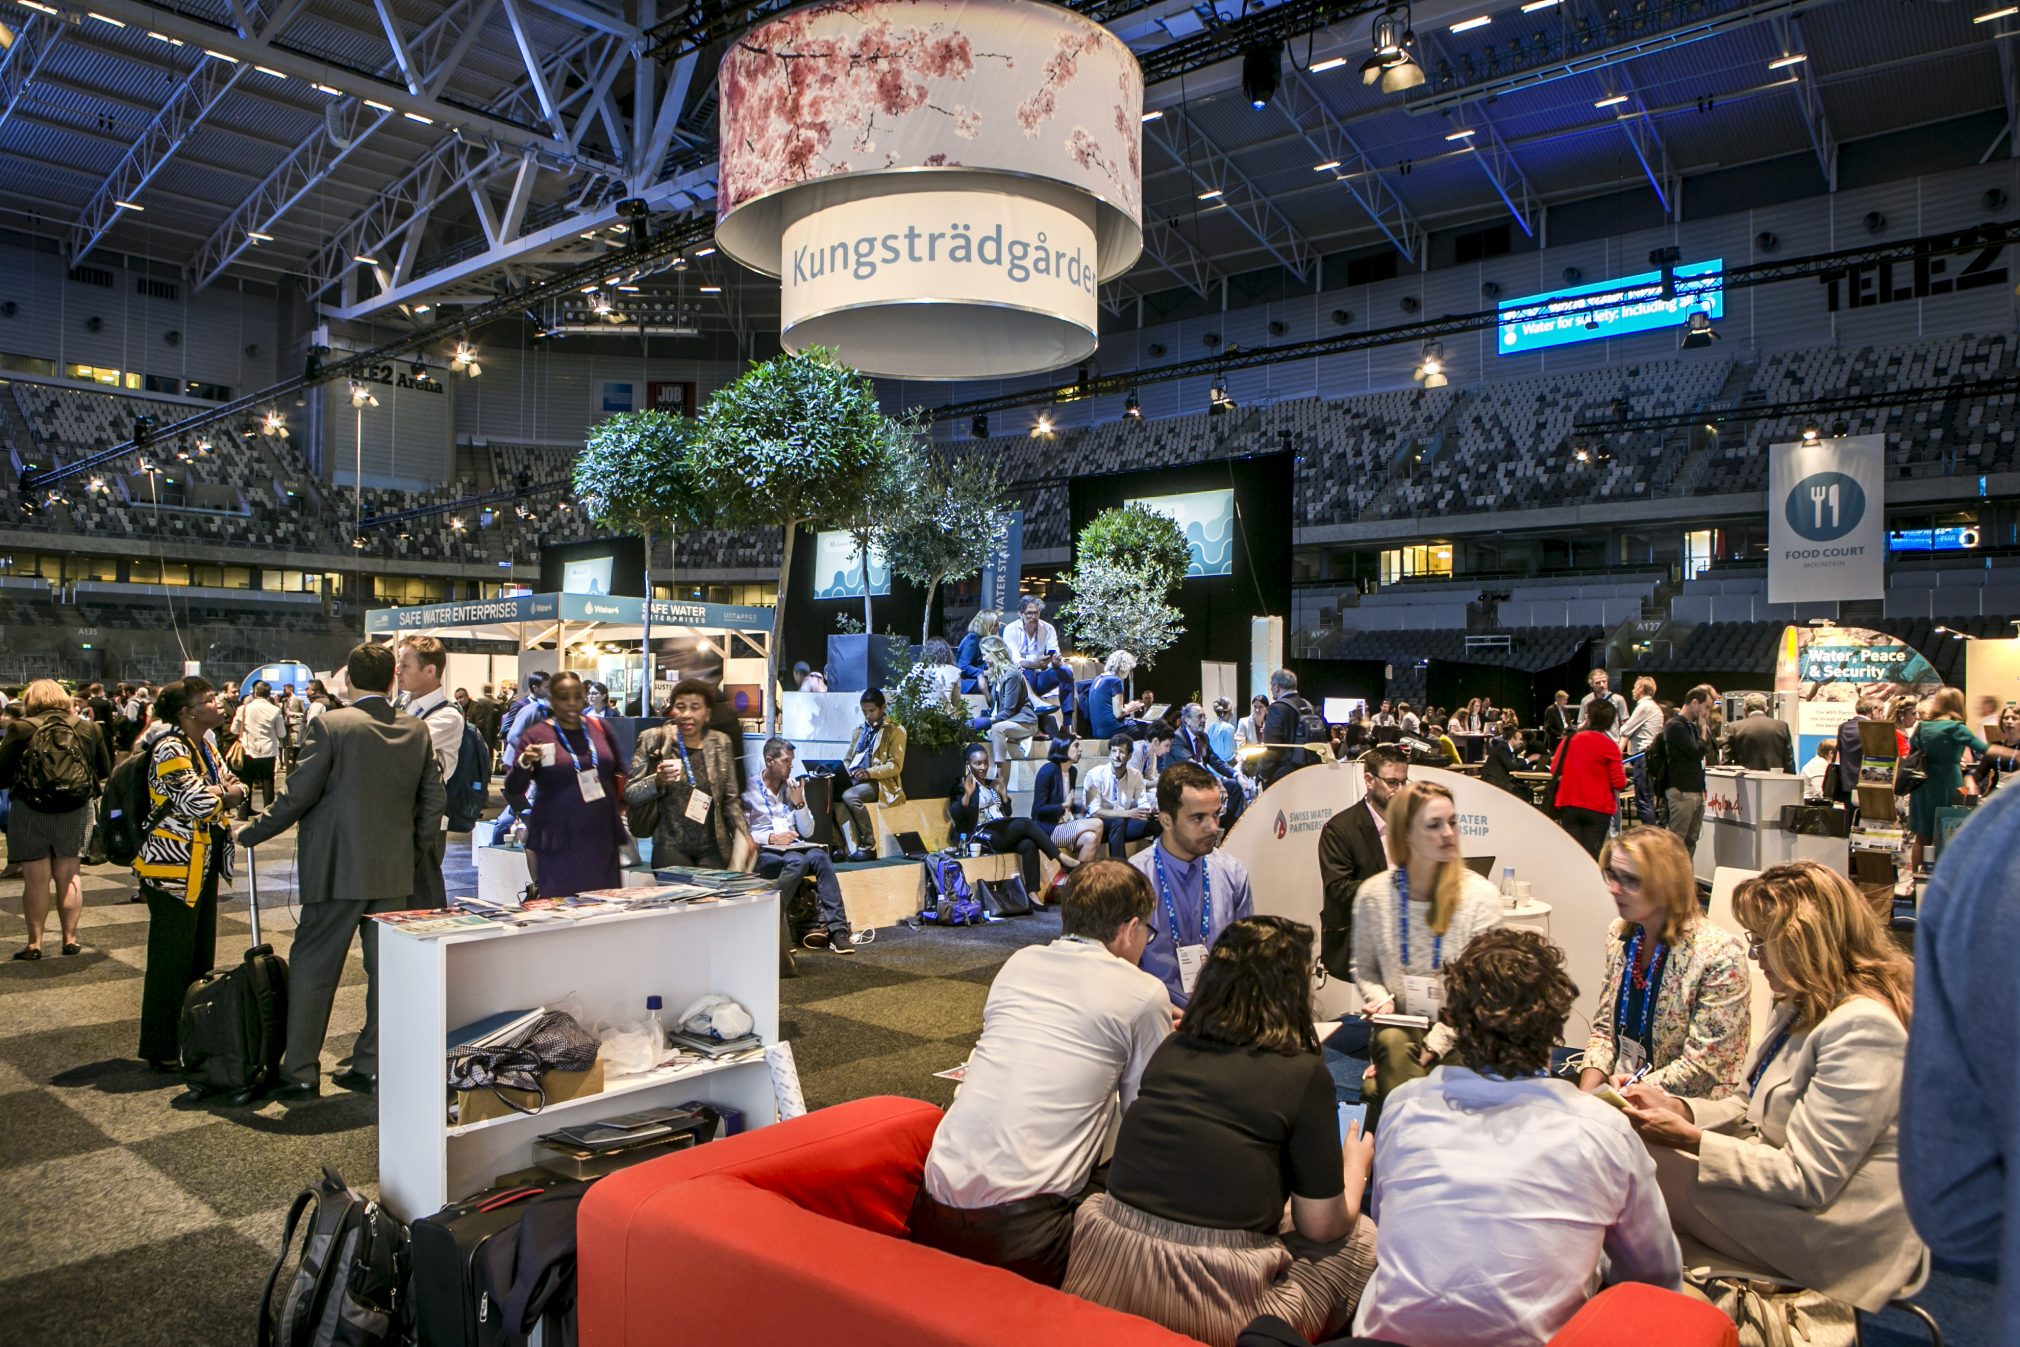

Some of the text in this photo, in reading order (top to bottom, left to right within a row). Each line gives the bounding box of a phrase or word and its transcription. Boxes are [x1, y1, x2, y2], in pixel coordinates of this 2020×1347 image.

[1820, 222, 2008, 312] TELE2
[1522, 322, 1555, 336] Water
[1557, 316, 1574, 330] for
[1621, 299, 1678, 319] Including
[658, 386, 682, 402] JOB
[1785, 546, 1865, 560] FOOD COURT
[1804, 560, 1846, 569] MOUNTAIN
[995, 575, 1006, 617] WATER
[400, 612, 422, 626] SAFE
[423, 606, 451, 624] WATER
[453, 601, 518, 621] ENTERPRISES
[671, 605, 706, 617] WATER
[642, 614, 706, 624] ETERPRISES
[1637, 622, 1660, 631] A127
[1808, 649, 1906, 664] Water, Peace
[1809, 665, 1886, 679] & Security
[654, 683, 673, 691] SUSTE
[1290, 809, 1332, 822] SWISS WATER
[1457, 813, 1488, 825] ATER
[1290, 821, 1324, 833] PARTNERS
